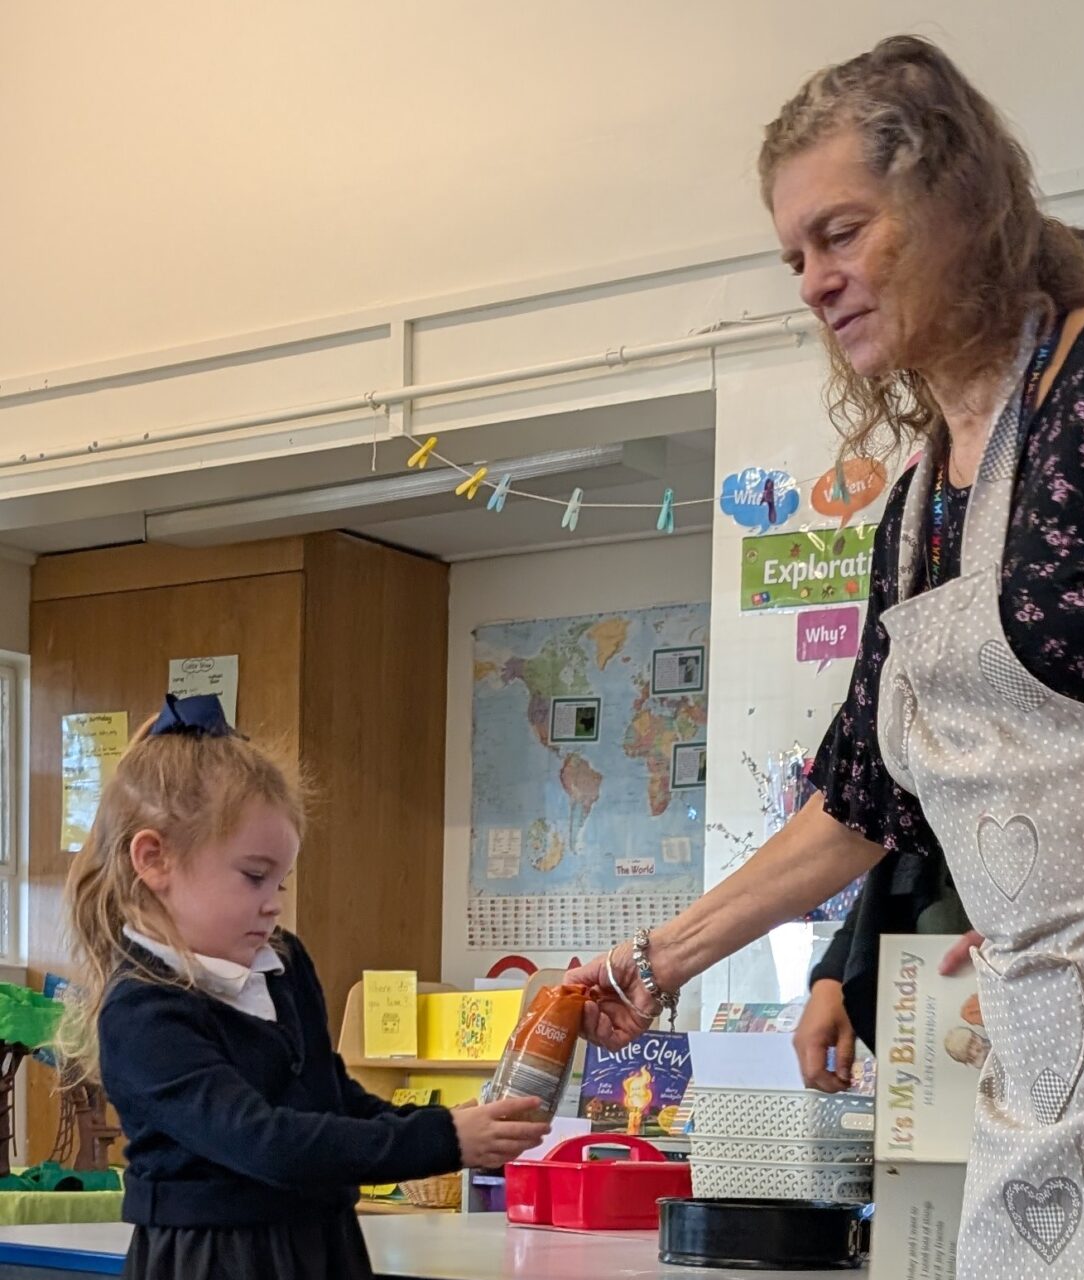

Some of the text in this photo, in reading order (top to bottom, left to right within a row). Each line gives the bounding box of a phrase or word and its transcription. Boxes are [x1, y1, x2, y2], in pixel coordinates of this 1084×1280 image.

[823, 473, 874, 503] Wen?
[805, 624, 847, 645] Why?
[616, 864, 655, 874] The World
[461, 1010, 486, 1031] SUPER
[535, 1023, 567, 1043] SUGAR
[643, 1039, 692, 1067] Glow
[888, 951, 925, 1152] It's My Birthday
